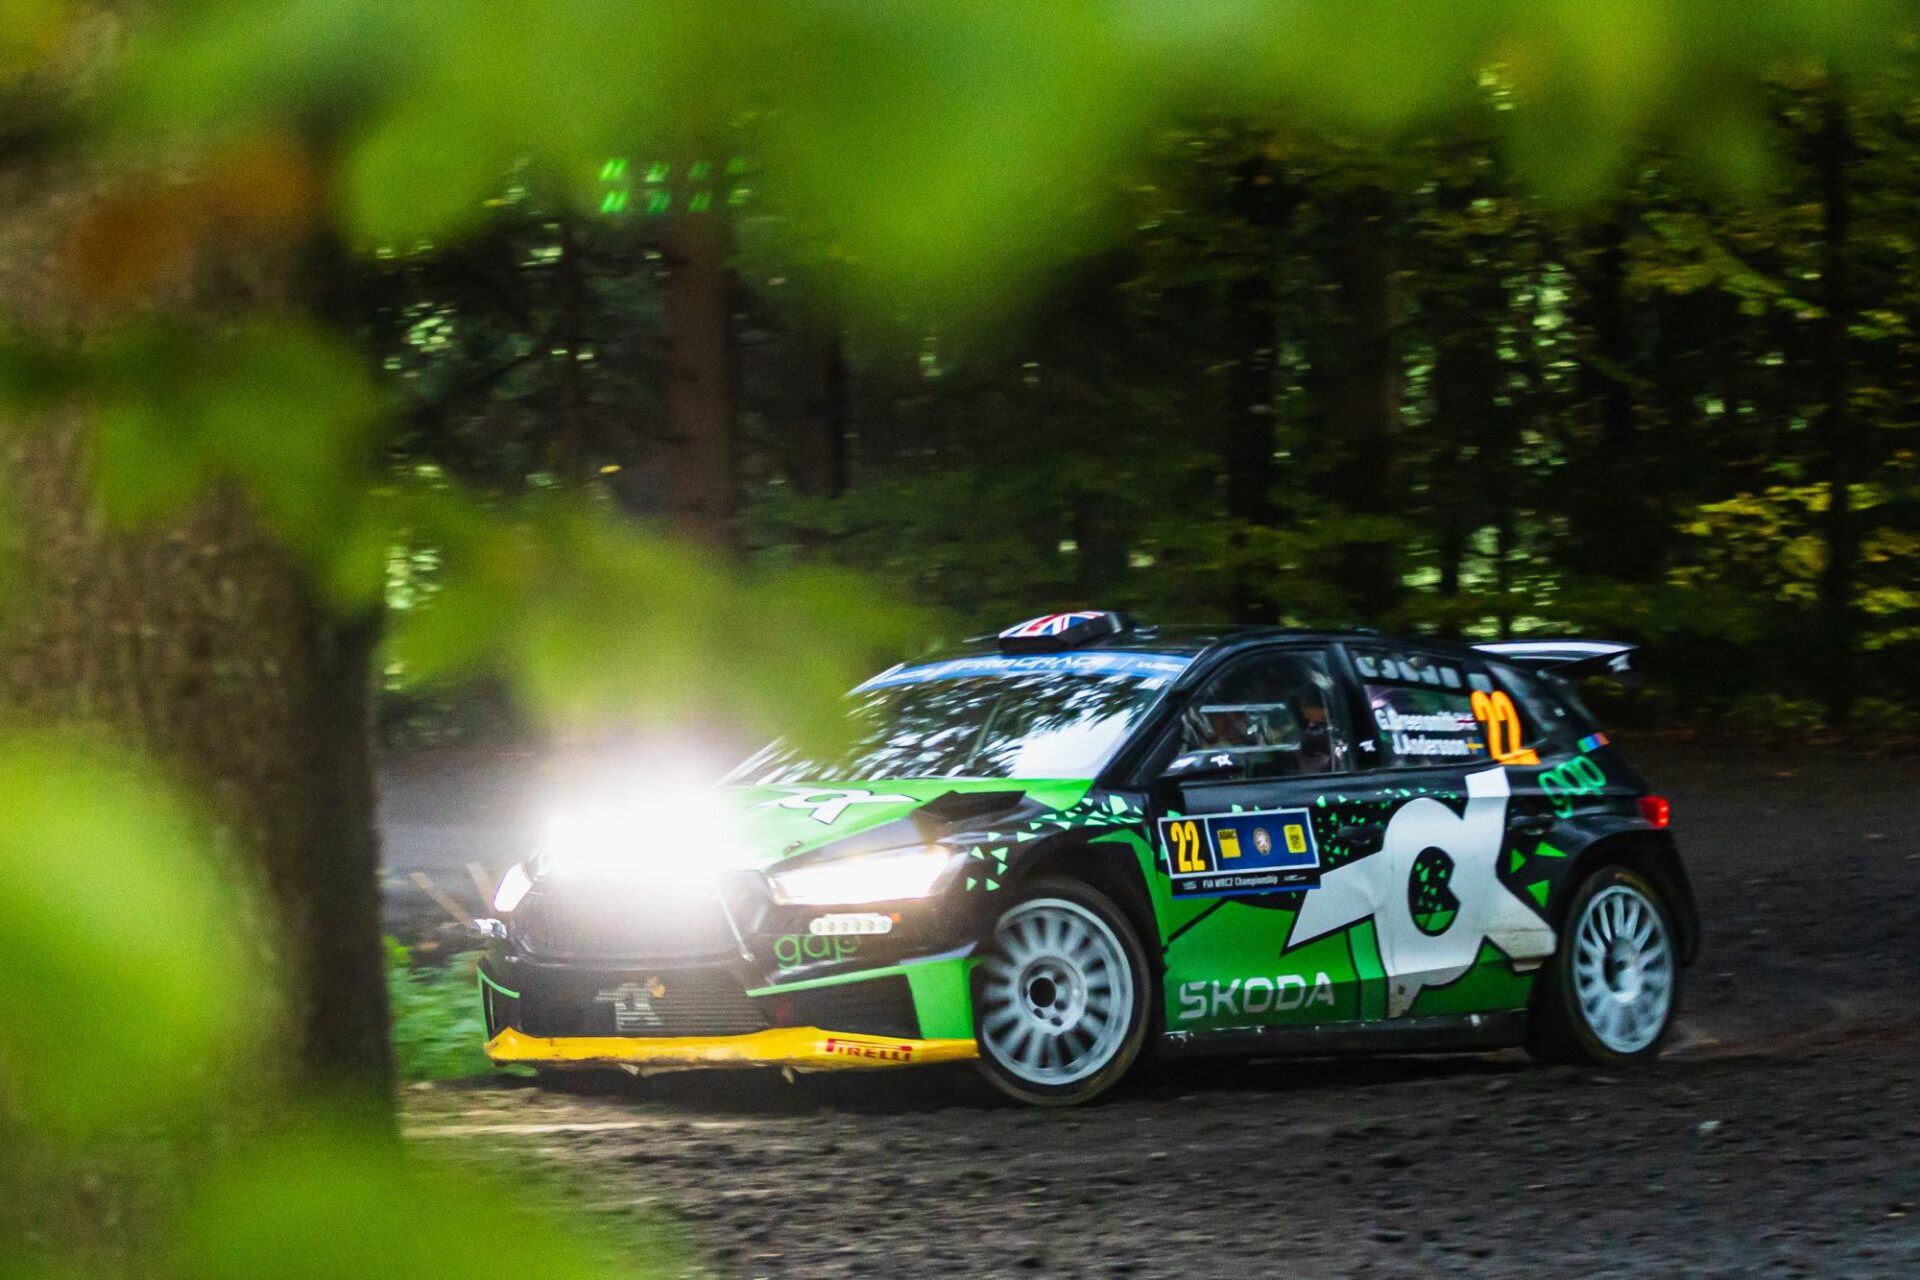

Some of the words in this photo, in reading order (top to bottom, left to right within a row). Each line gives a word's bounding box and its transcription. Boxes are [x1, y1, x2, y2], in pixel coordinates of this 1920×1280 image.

[1471, 691, 1541, 766] 22
[1170, 821, 1206, 873] 22
[826, 1038, 912, 1062] PIRELLI
